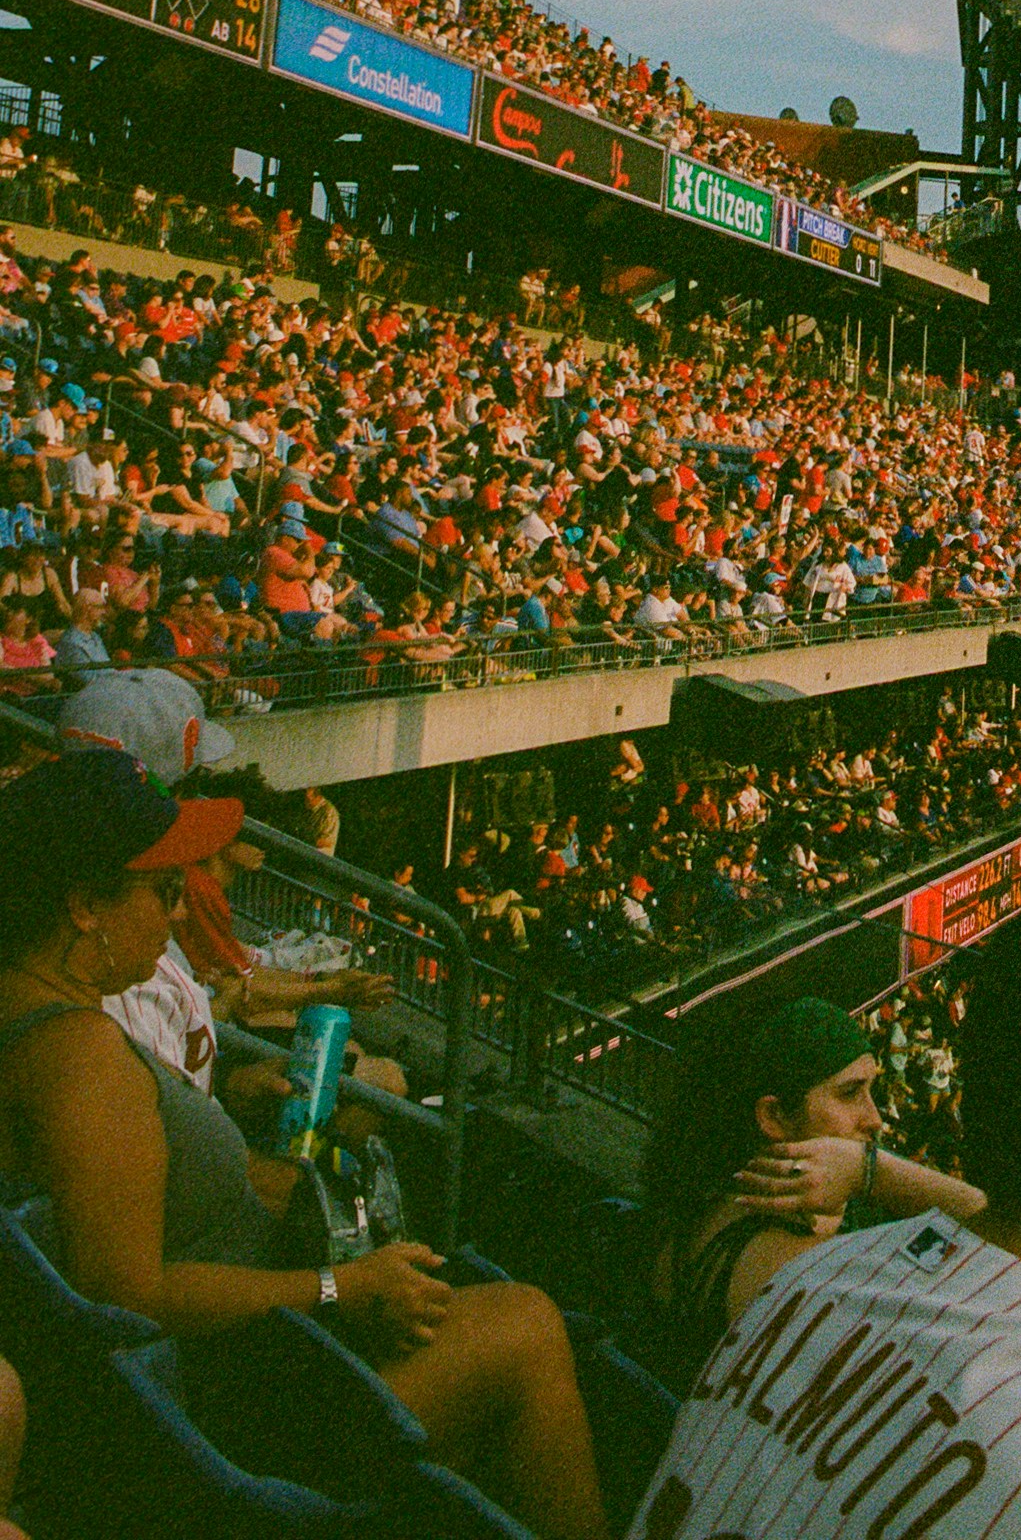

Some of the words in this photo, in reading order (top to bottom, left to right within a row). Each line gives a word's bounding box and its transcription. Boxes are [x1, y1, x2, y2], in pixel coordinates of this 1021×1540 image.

[211, 19, 230, 42] AB
[236, 18, 256, 51] 14
[348, 54, 442, 115] Constellation
[694, 171, 764, 236] Citizens
[811, 238, 840, 267] CUTTER
[945, 874, 978, 908] DISTANCE
[959, 912, 976, 938] VELO
